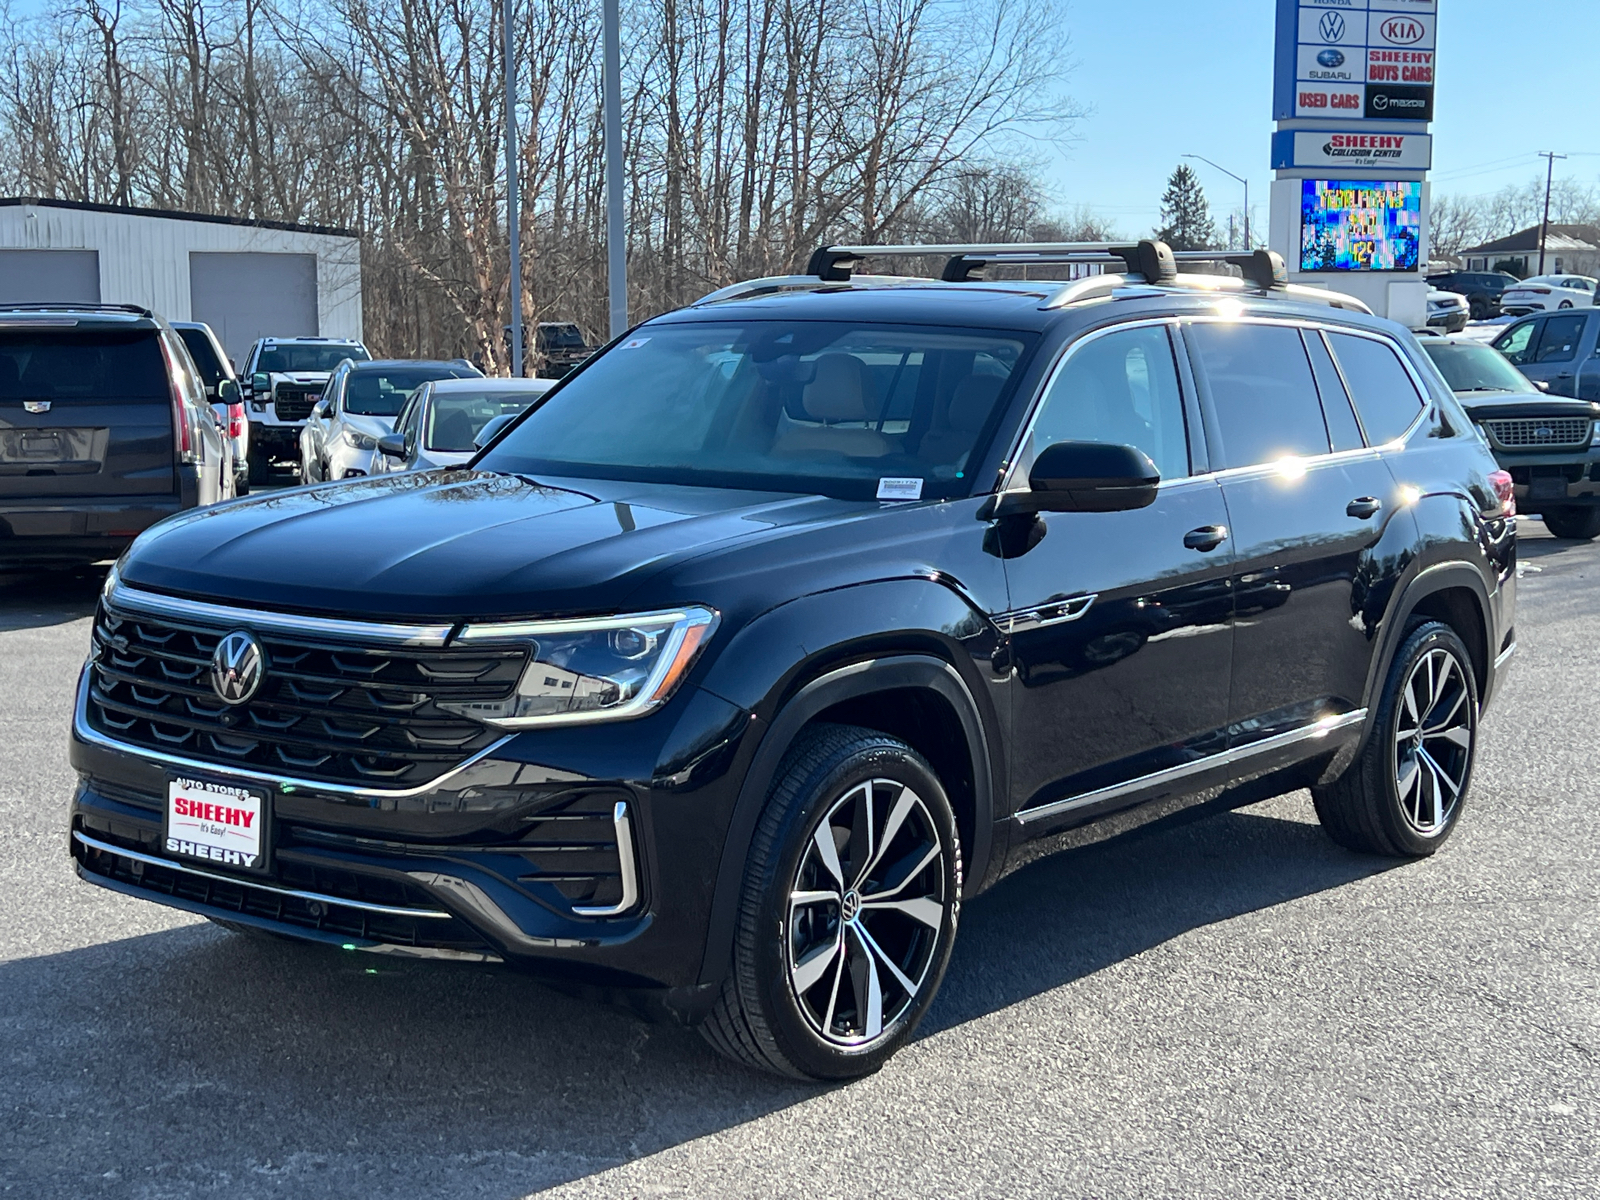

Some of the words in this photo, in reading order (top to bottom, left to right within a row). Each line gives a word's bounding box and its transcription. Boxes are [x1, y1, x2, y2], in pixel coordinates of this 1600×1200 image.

[1388, 23, 1417, 39] KIA
[1369, 51, 1432, 63] SHEEHY
[1309, 71, 1351, 80] SUBARU
[1369, 65, 1399, 81] BUYS
[1402, 66, 1432, 82] CARS
[1299, 93, 1328, 108] USED
[1331, 94, 1360, 109] CARS
[1389, 99, 1425, 107] mazda
[1331, 135, 1404, 148] SHEEHY
[1331, 149, 1371, 157] COLLISION
[1373, 150, 1402, 158] CENTER
[176, 777, 204, 790] AUTO
[205, 783, 250, 799] STORES
[175, 797, 255, 828] SHEEHY
[200, 822, 209, 833] It's
[210, 824, 227, 838] Easy!
[166, 838, 256, 867] SHEEHY
